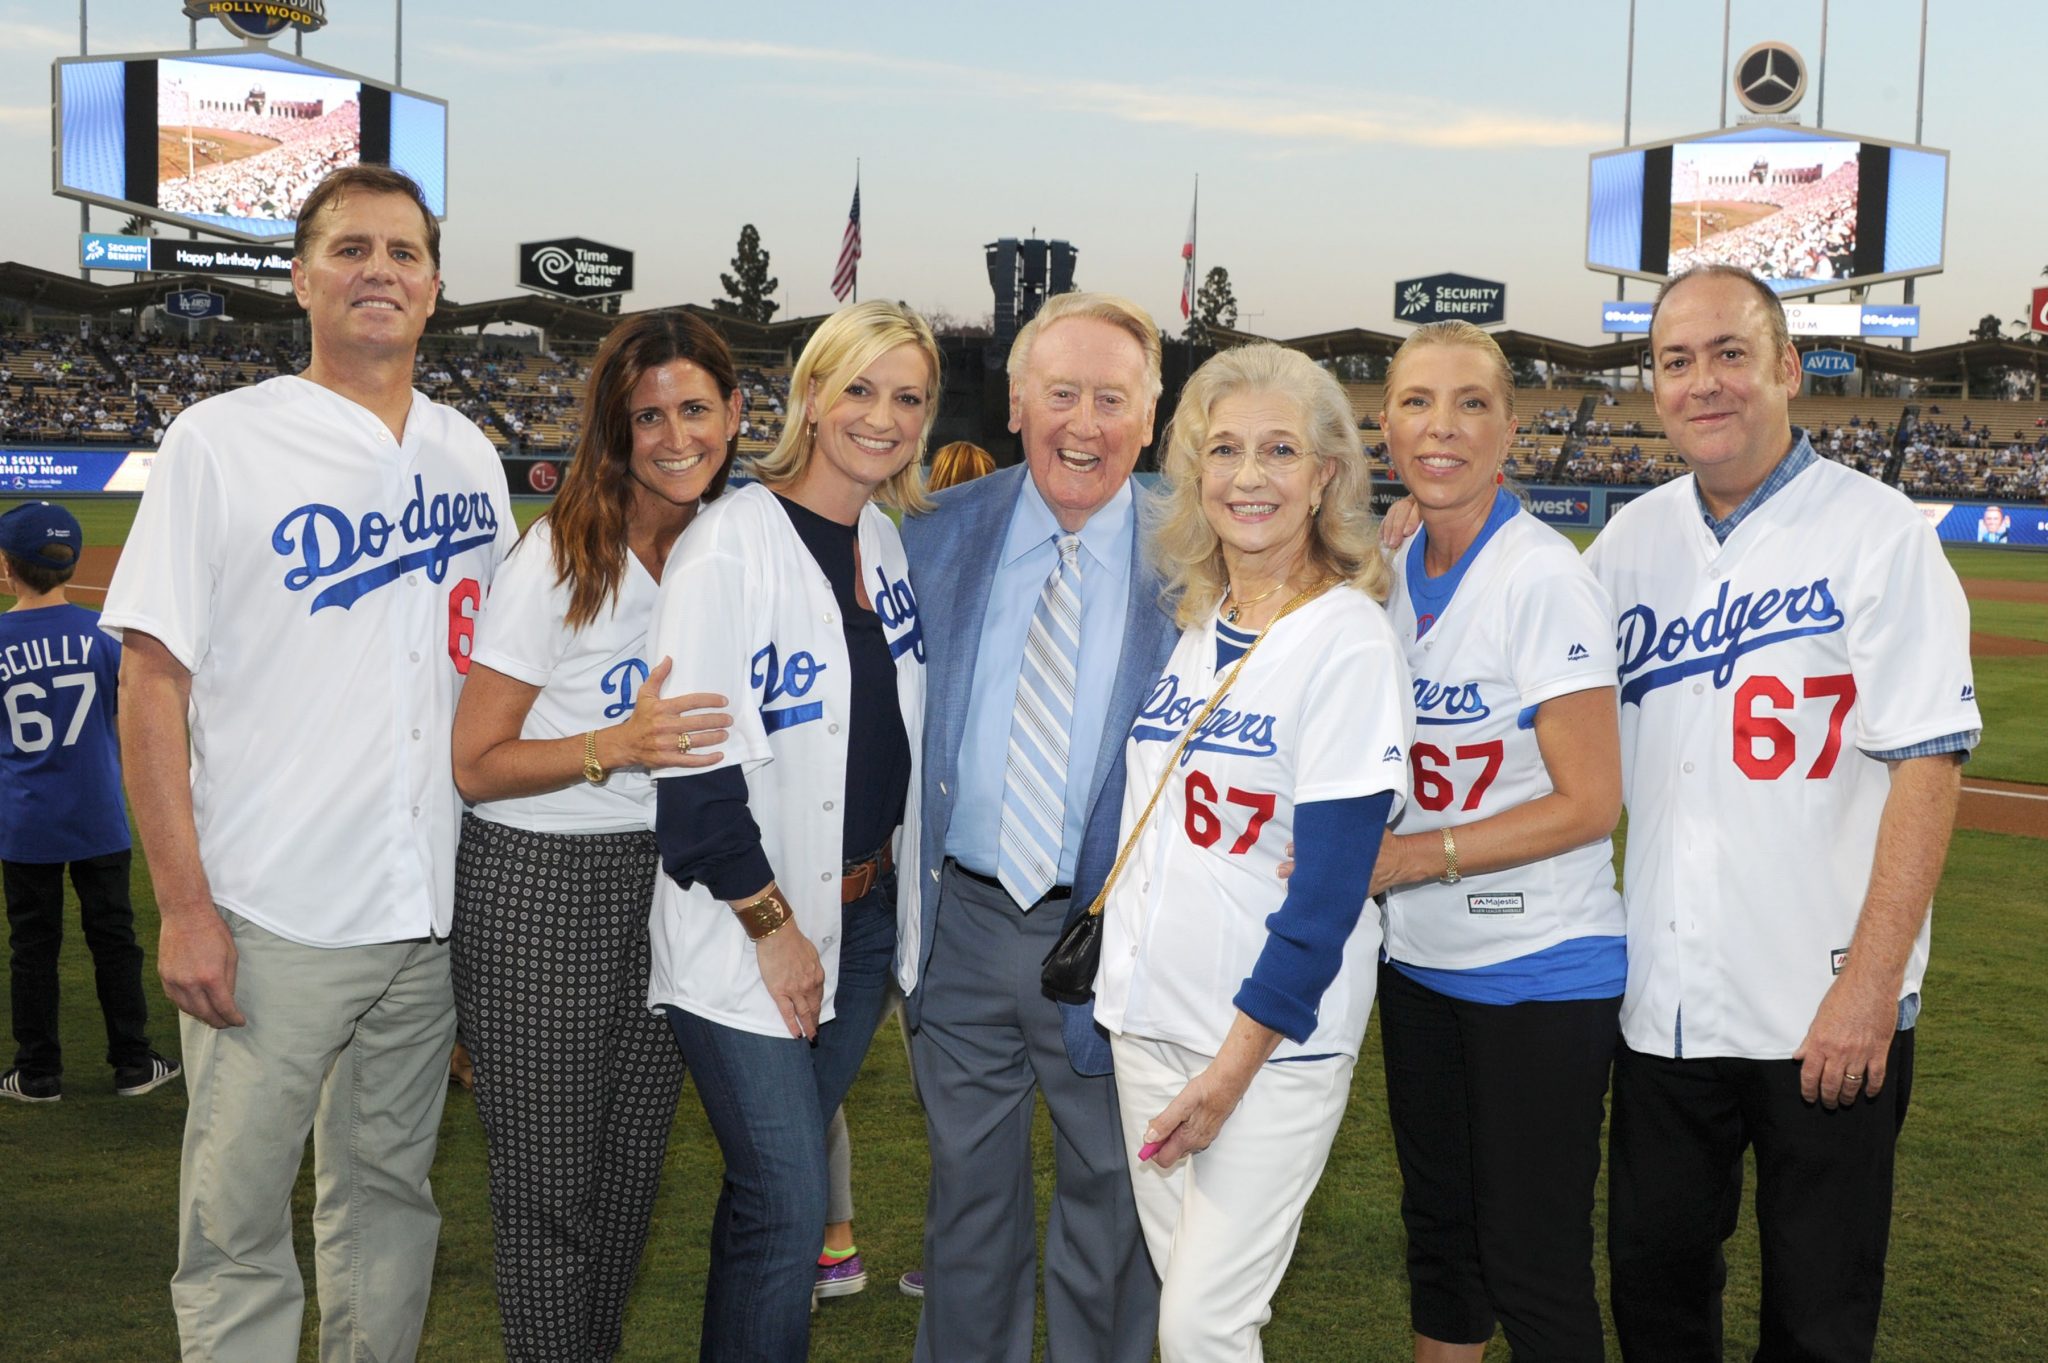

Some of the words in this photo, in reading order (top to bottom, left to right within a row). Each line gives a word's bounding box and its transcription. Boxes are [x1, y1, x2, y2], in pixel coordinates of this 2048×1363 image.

[209, 2, 312, 25] HOLLYWOOD
[107, 243, 148, 252] SECURITY
[107, 252, 143, 262] BENEFIT
[176, 250, 214, 267] Happy
[215, 252, 261, 270] Birthday
[263, 255, 292, 269] Alliso
[575, 249, 608, 262] Time
[575, 261, 623, 275] Warner
[574, 274, 613, 287] Cable
[1436, 286, 1499, 299] SECURITY
[1435, 300, 1489, 313] BENEFIT
[1806, 356, 1850, 370] AVITA
[11, 456, 54, 465] SCULLY
[40, 466, 78, 475] NIGHT
[272, 473, 498, 592] Dodgers
[448, 577, 482, 676] 6
[1616, 577, 1845, 690] Dodgers
[0, 635, 93, 682] SCULLY
[3, 672, 97, 753] 67
[1733, 673, 1857, 781] 67
[1410, 739, 1504, 812] 67
[1185, 770, 1276, 855] 67
[1485, 898, 1519, 907] Majestic
